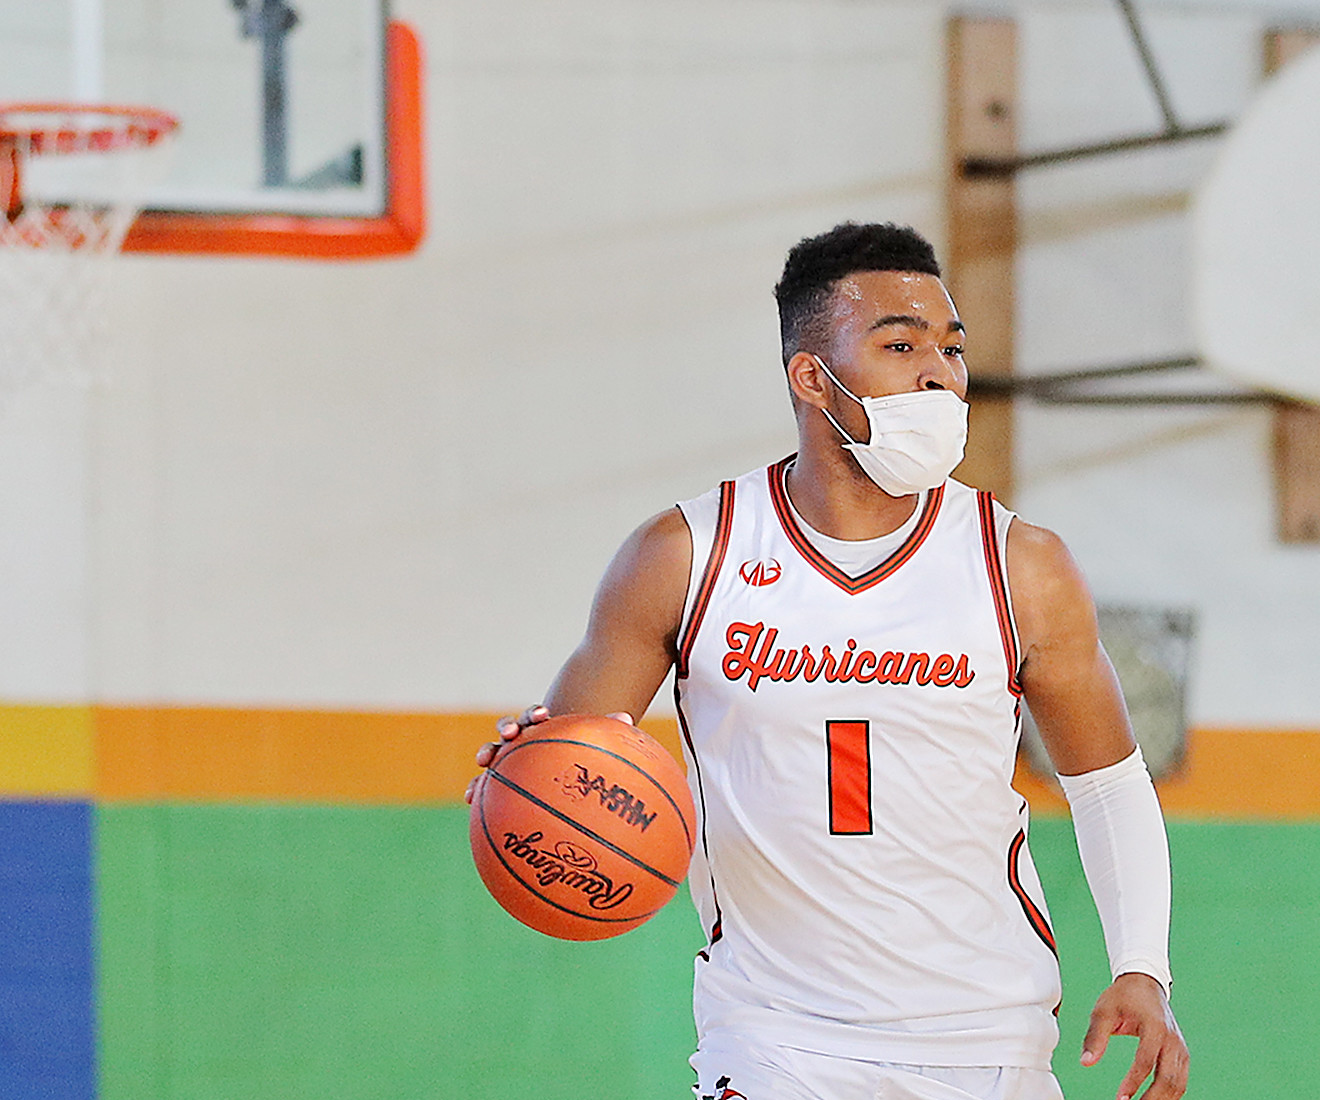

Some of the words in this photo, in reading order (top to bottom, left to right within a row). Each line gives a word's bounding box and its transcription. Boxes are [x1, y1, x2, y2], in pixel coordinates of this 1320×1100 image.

[722, 621, 975, 692] Hurricanes
[826, 720, 873, 835] 1
[503, 831, 633, 910] Rawlings
